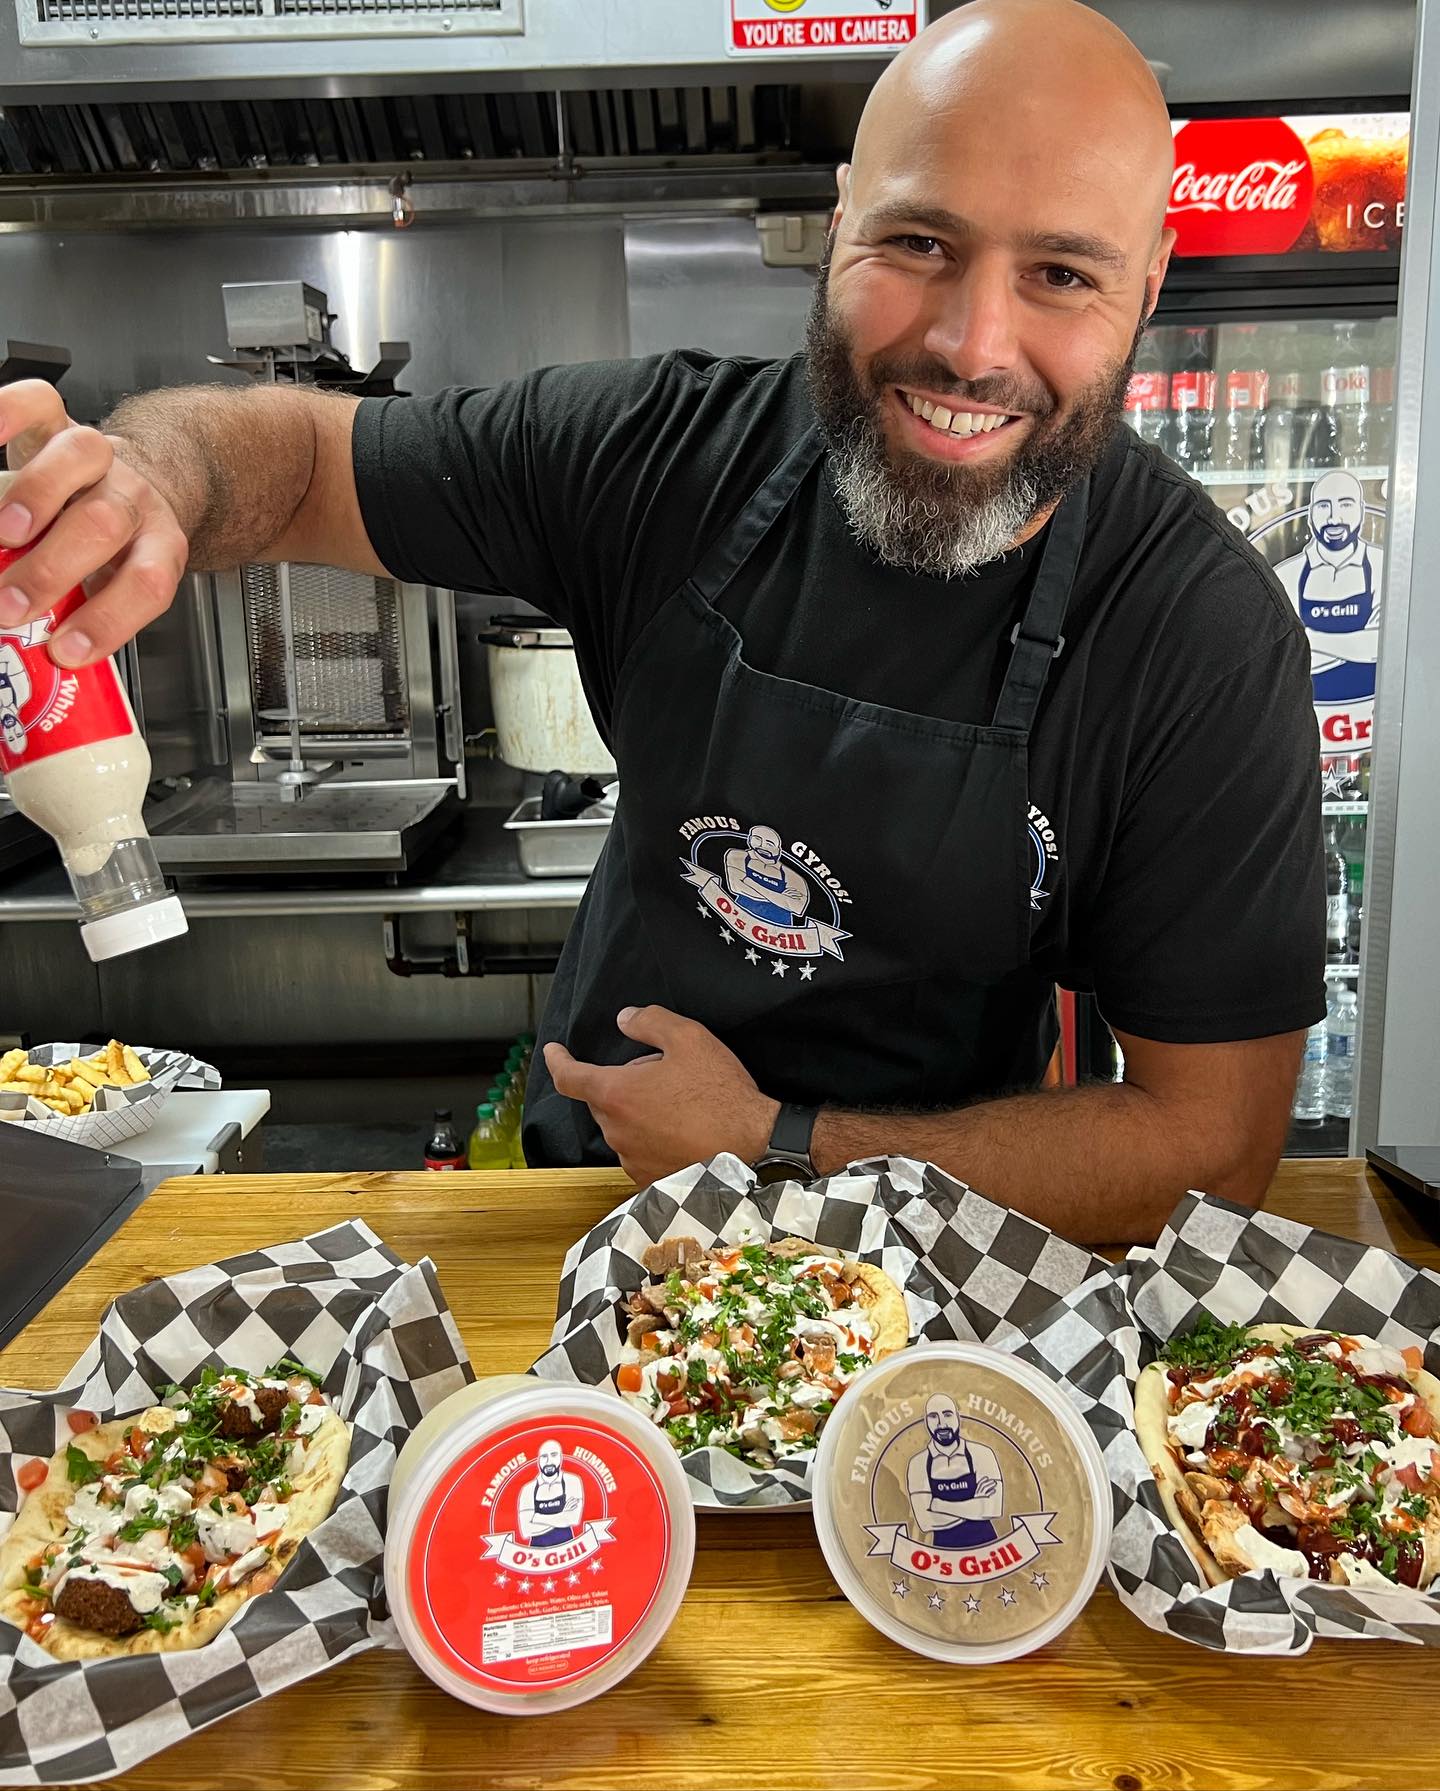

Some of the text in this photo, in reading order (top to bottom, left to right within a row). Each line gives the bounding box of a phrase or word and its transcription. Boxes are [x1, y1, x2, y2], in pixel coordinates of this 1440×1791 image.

[742, 18, 910, 46] YOU'RE ON CAMERA
[1227, 481, 1294, 532] OUS
[1331, 604, 1358, 617] Grill
[39, 674, 80, 732] White
[1322, 714, 1372, 742] Gr
[1028, 801, 1059, 861] YROS!
[679, 815, 853, 905] FAMOUS GYROS!
[716, 897, 807, 951] O's Grill
[851, 1392, 1054, 1485] FAMOUS HUMMUS
[480, 1445, 617, 1508] FAMOUS HUMMUS
[512, 1541, 588, 1567] O's Grill
[910, 1542, 1023, 1576] O's Grill
